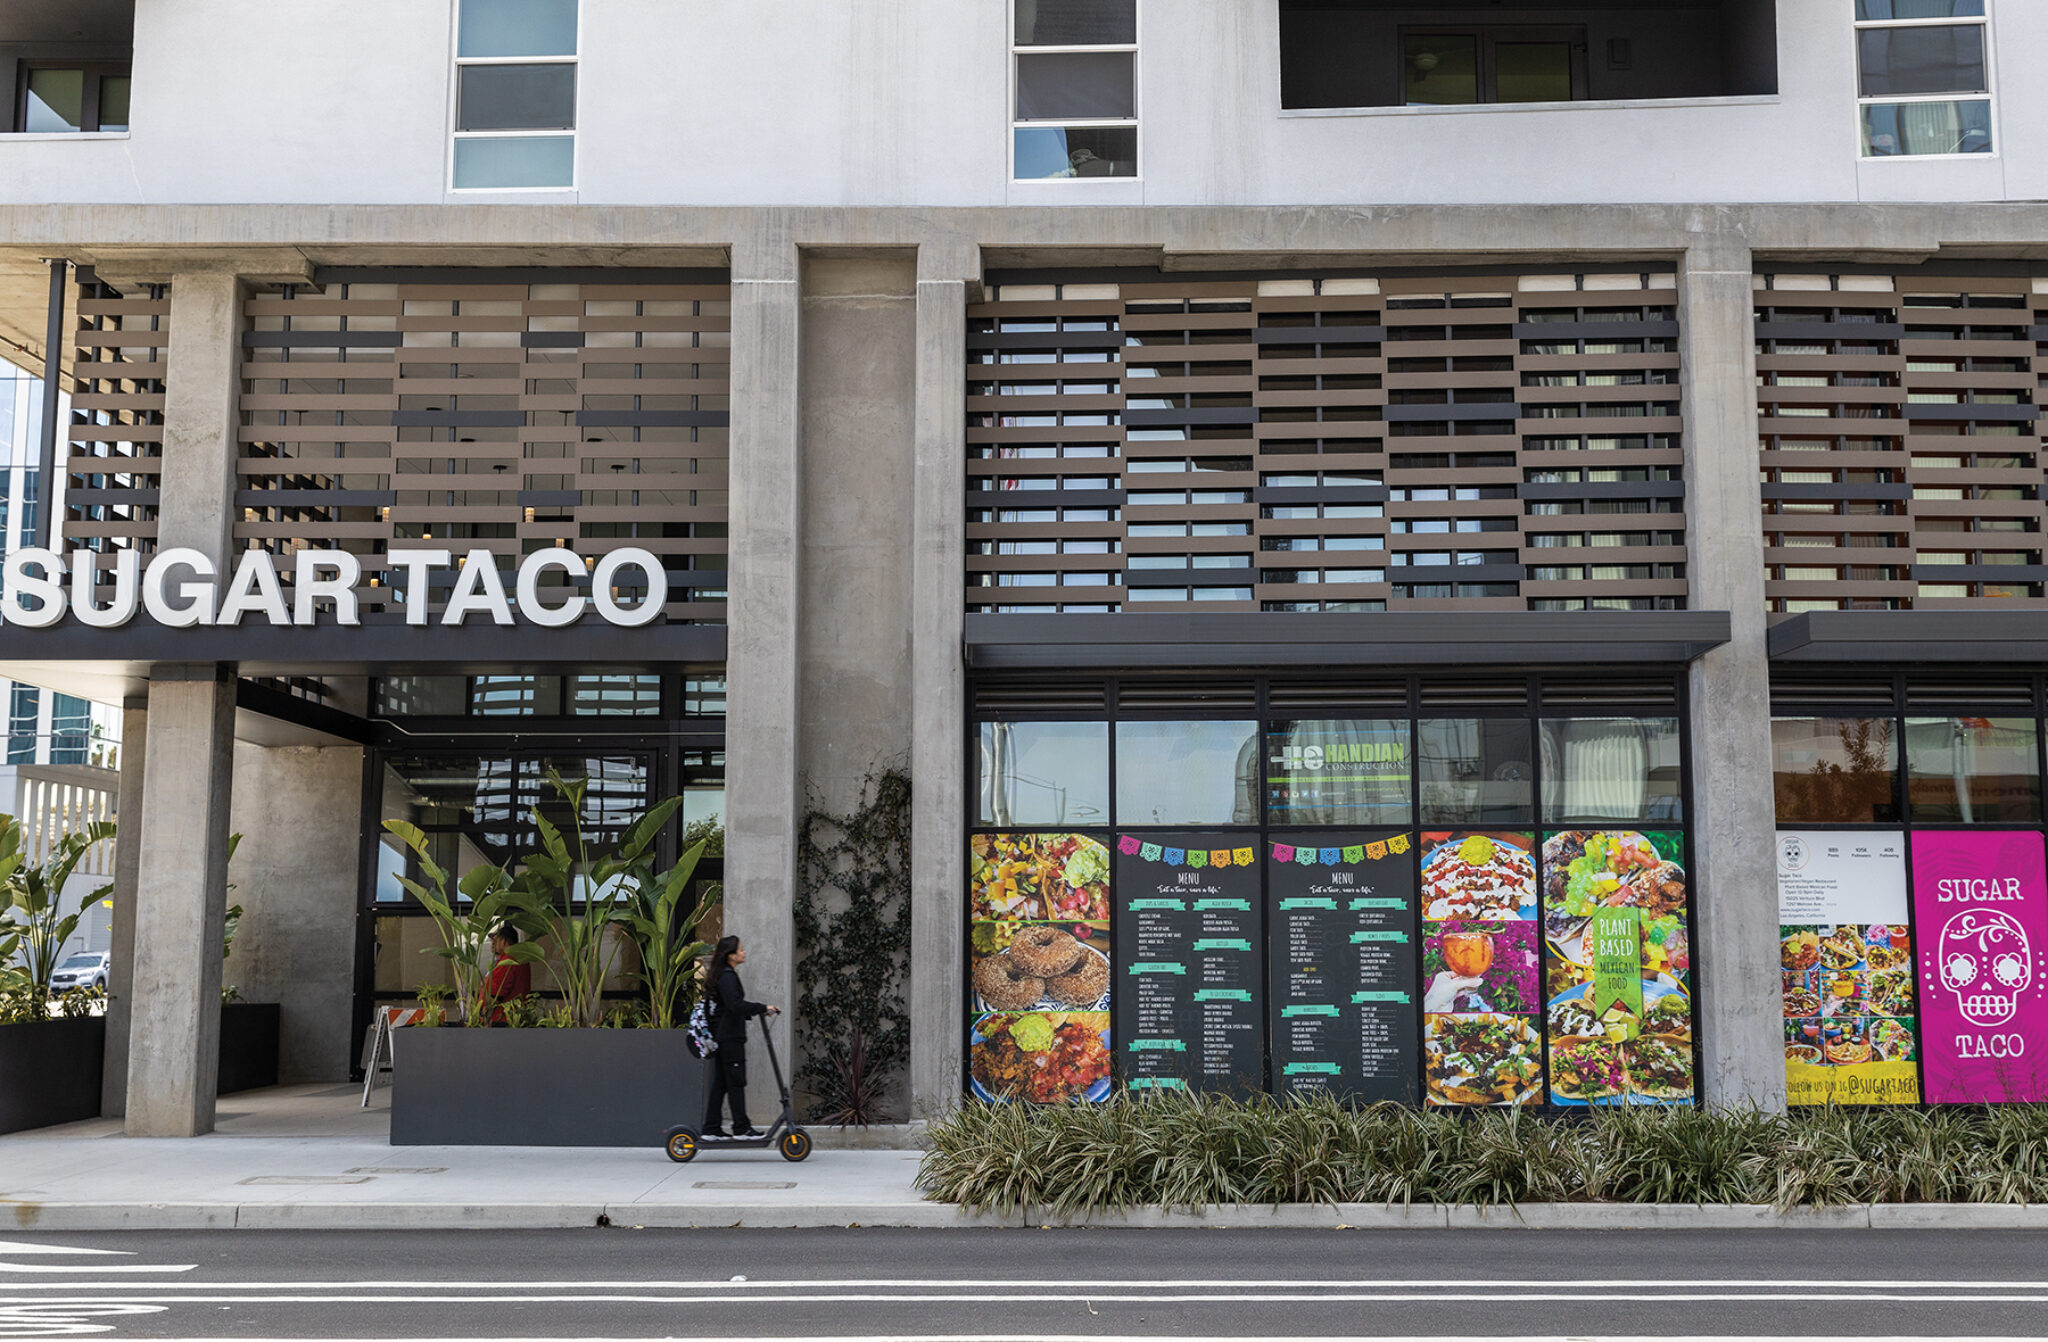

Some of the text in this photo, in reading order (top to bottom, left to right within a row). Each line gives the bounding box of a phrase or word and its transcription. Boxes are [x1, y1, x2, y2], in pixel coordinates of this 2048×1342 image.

[1, 547, 669, 628] SUGAR TACO
[1325, 744, 1404, 763] HANDIAN
[1325, 762, 1405, 771] CONSTRUCTION
[1178, 872, 1199, 885] MENU
[1332, 872, 1354, 885] MENU
[1938, 878, 2024, 902] SUGAR
[1600, 918, 1632, 936] PLANT
[1600, 939, 1633, 956] BASED
[1600, 962, 1634, 974] MEXICAN
[1608, 977, 1628, 990] FOOD
[1956, 1034, 2024, 1058] TACO
[1787, 1075, 1916, 1095] OLLOW US ON IG @SUGARTACO
